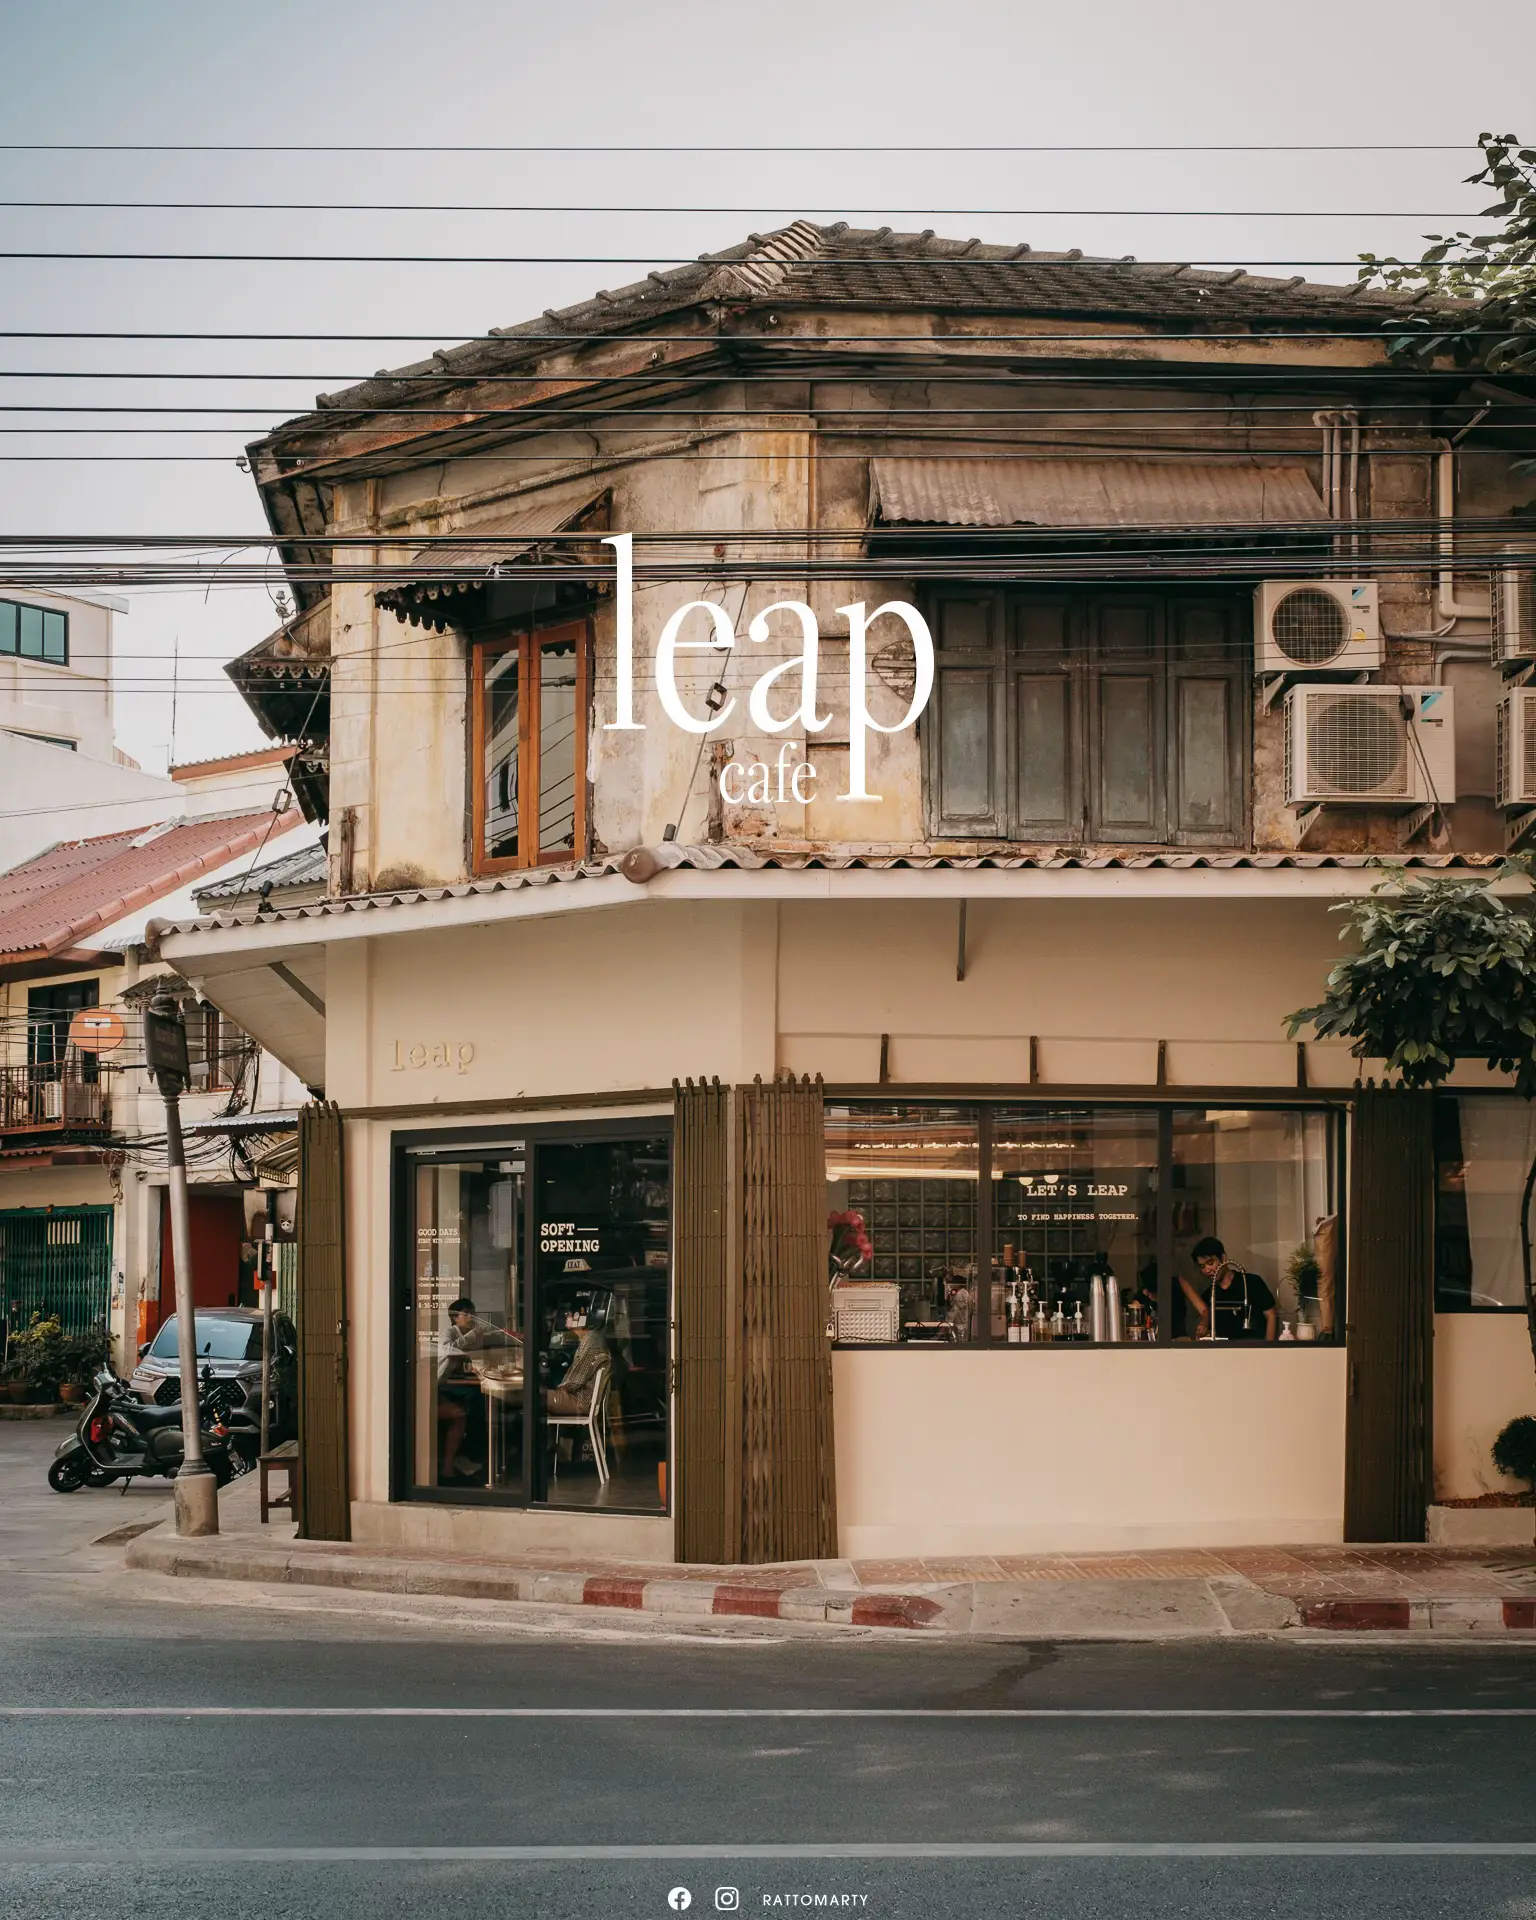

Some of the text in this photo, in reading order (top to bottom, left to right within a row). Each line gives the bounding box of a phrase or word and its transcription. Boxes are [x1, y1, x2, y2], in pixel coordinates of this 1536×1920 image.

[388, 1039, 475, 1076] leap
[1026, 1184, 1128, 1197] LET'S LEAP
[417, 1228, 459, 1236] GOOD DAYS
[540, 1223, 575, 1236] SOFT
[540, 1239, 600, 1253] OPENING
